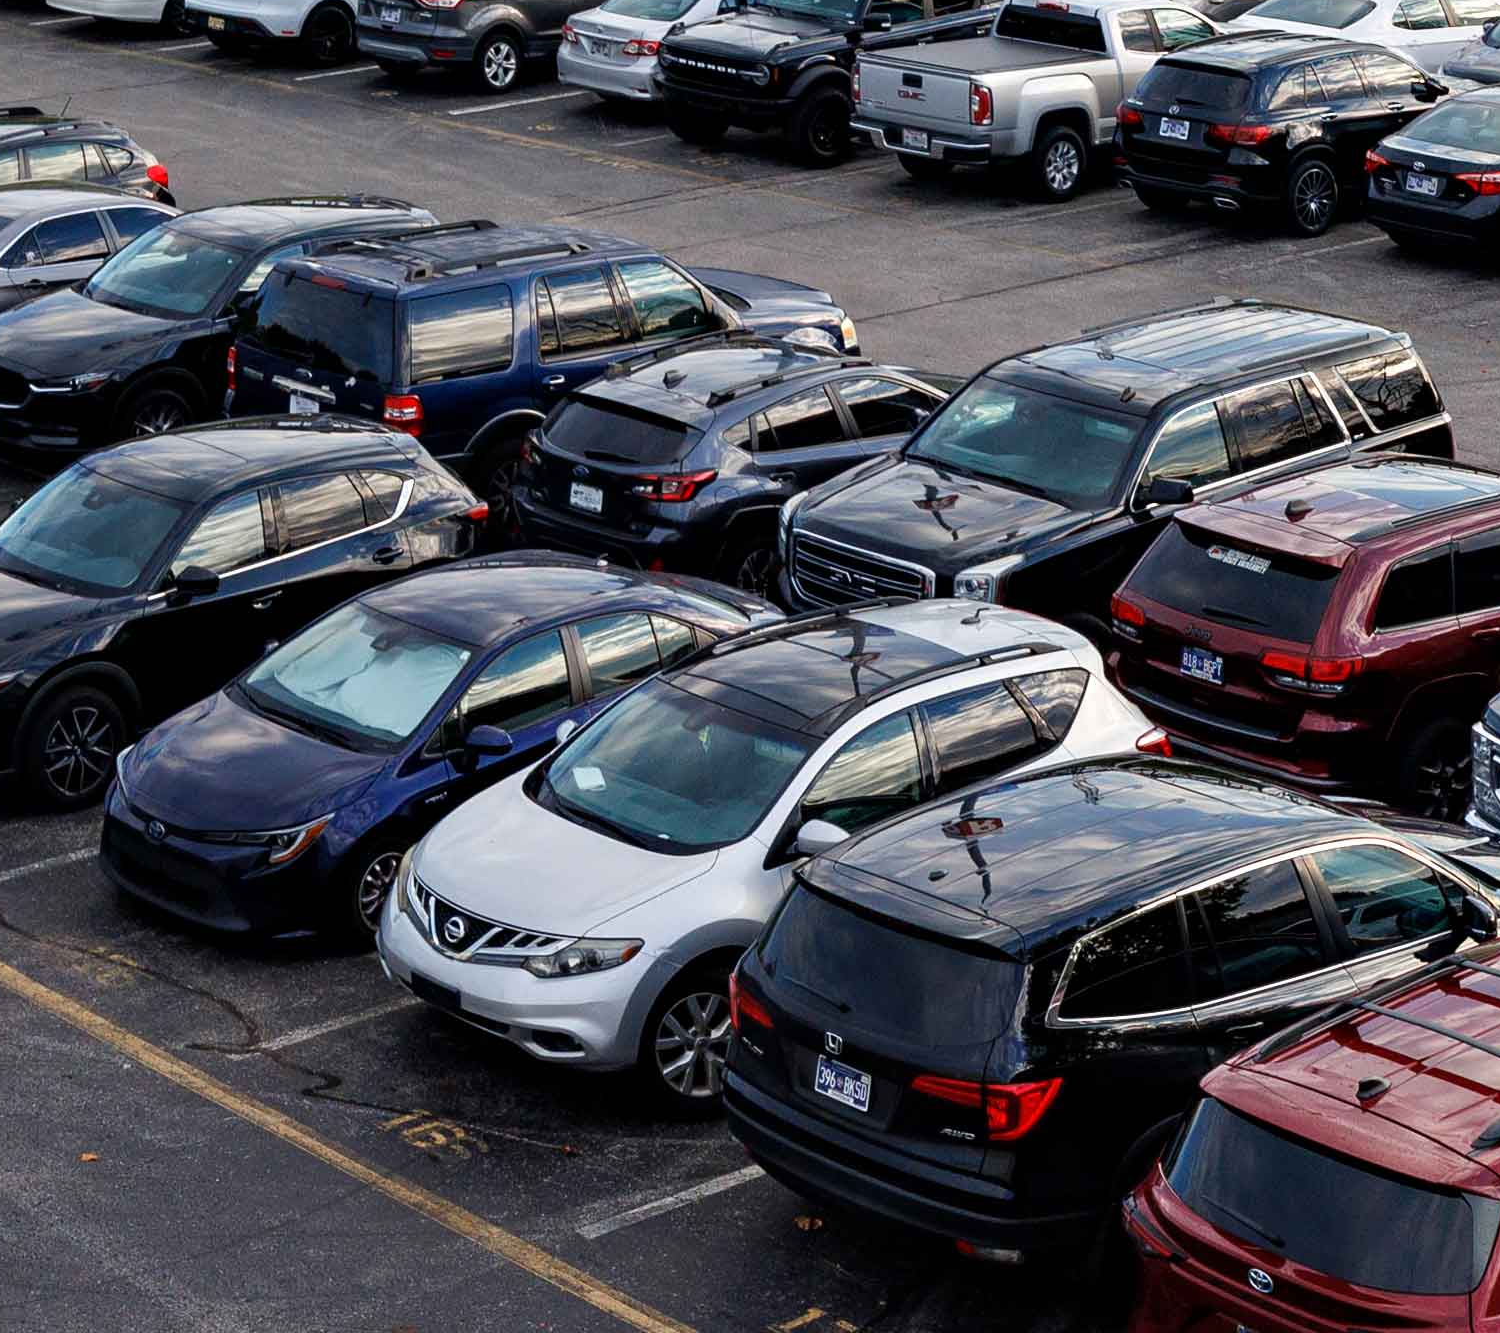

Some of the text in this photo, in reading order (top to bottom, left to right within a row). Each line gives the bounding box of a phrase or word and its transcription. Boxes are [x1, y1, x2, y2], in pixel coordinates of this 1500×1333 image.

[1182, 651, 1198, 669] 818
[819, 1066, 867, 1102] 396 BKSD
[940, 1127, 976, 1141] AWD
